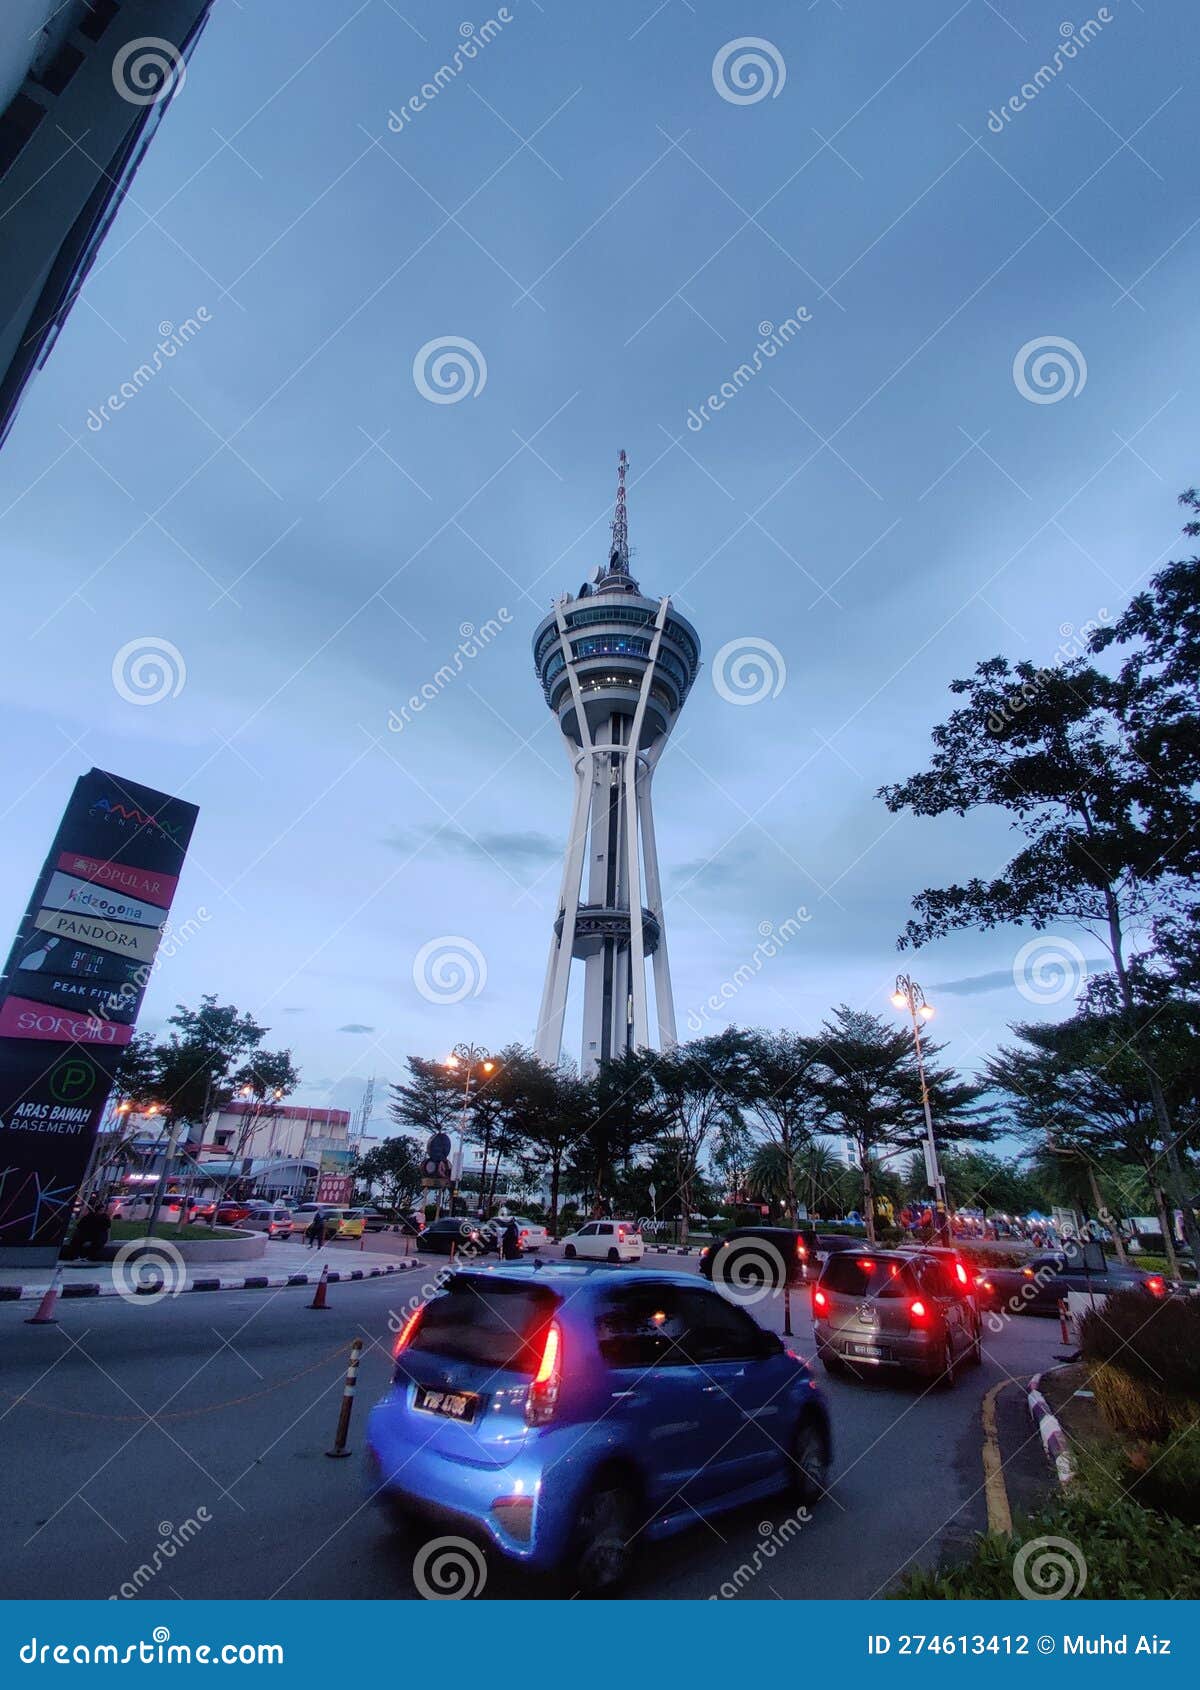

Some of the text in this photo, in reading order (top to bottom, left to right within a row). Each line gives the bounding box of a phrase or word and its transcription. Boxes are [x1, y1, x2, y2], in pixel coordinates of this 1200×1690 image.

[88, 863, 161, 894] POPULAR
[56, 917, 139, 949] PANDORA
[53, 980, 87, 995] PEAK
[14, 1102, 92, 1122] ARAS BAWAH
[10, 1118, 87, 1134] BASEMENT
